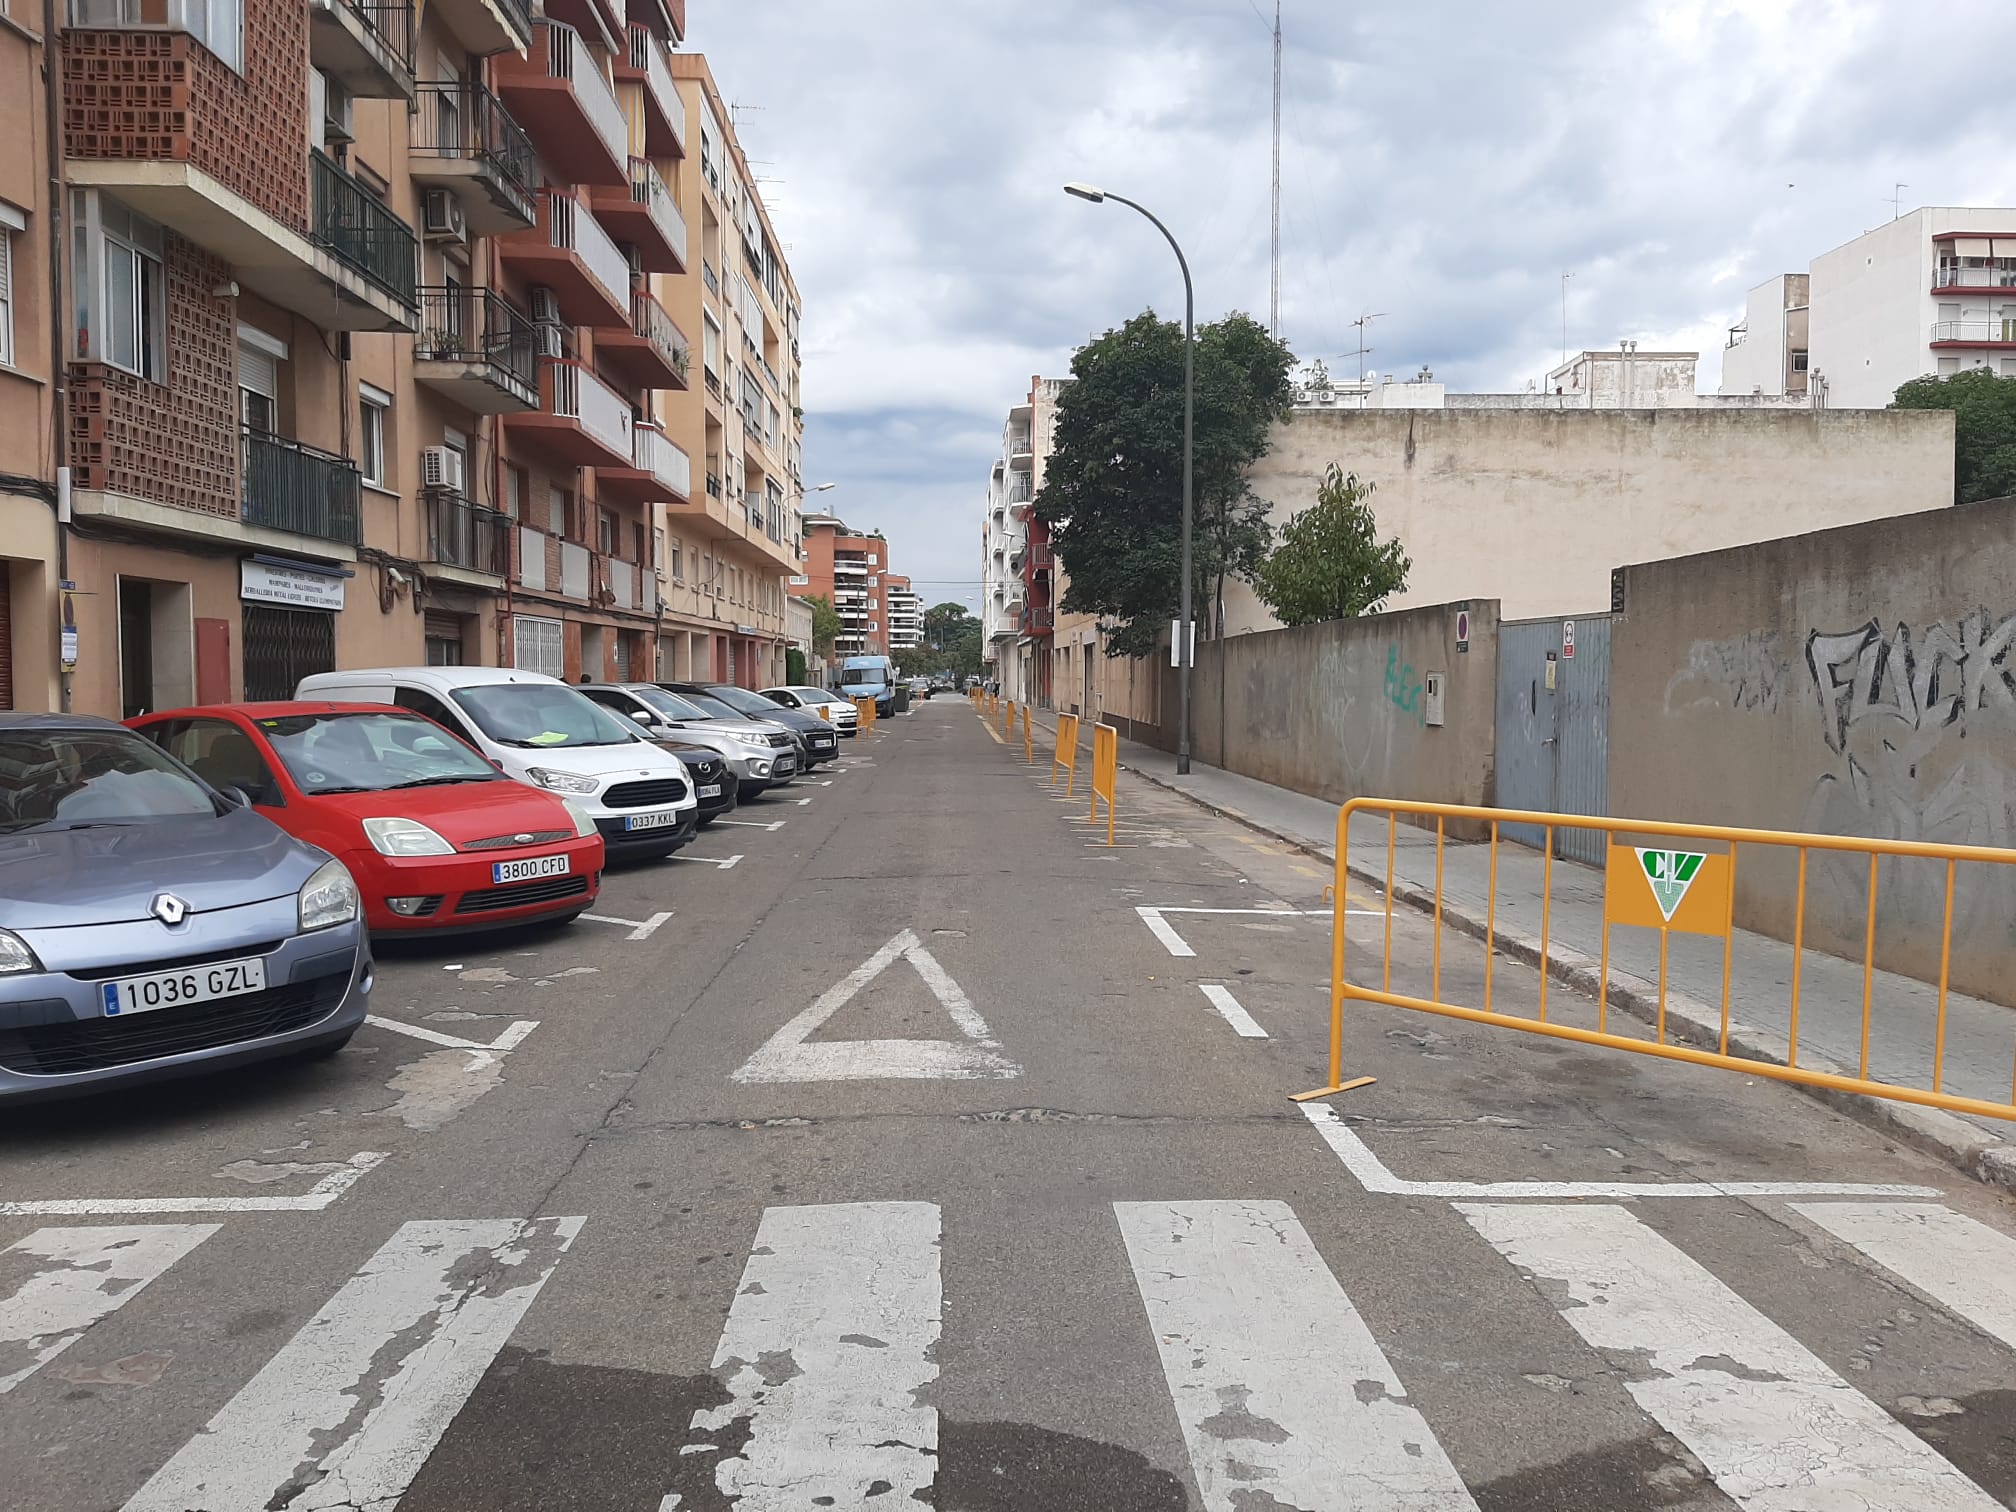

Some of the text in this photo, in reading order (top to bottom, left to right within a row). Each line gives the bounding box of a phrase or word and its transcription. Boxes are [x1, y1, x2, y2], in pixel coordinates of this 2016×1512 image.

[632, 811, 674, 828] 0337 KKL
[503, 857, 565, 879] 3800 CFD
[128, 966, 257, 1008] 1036 GZL
